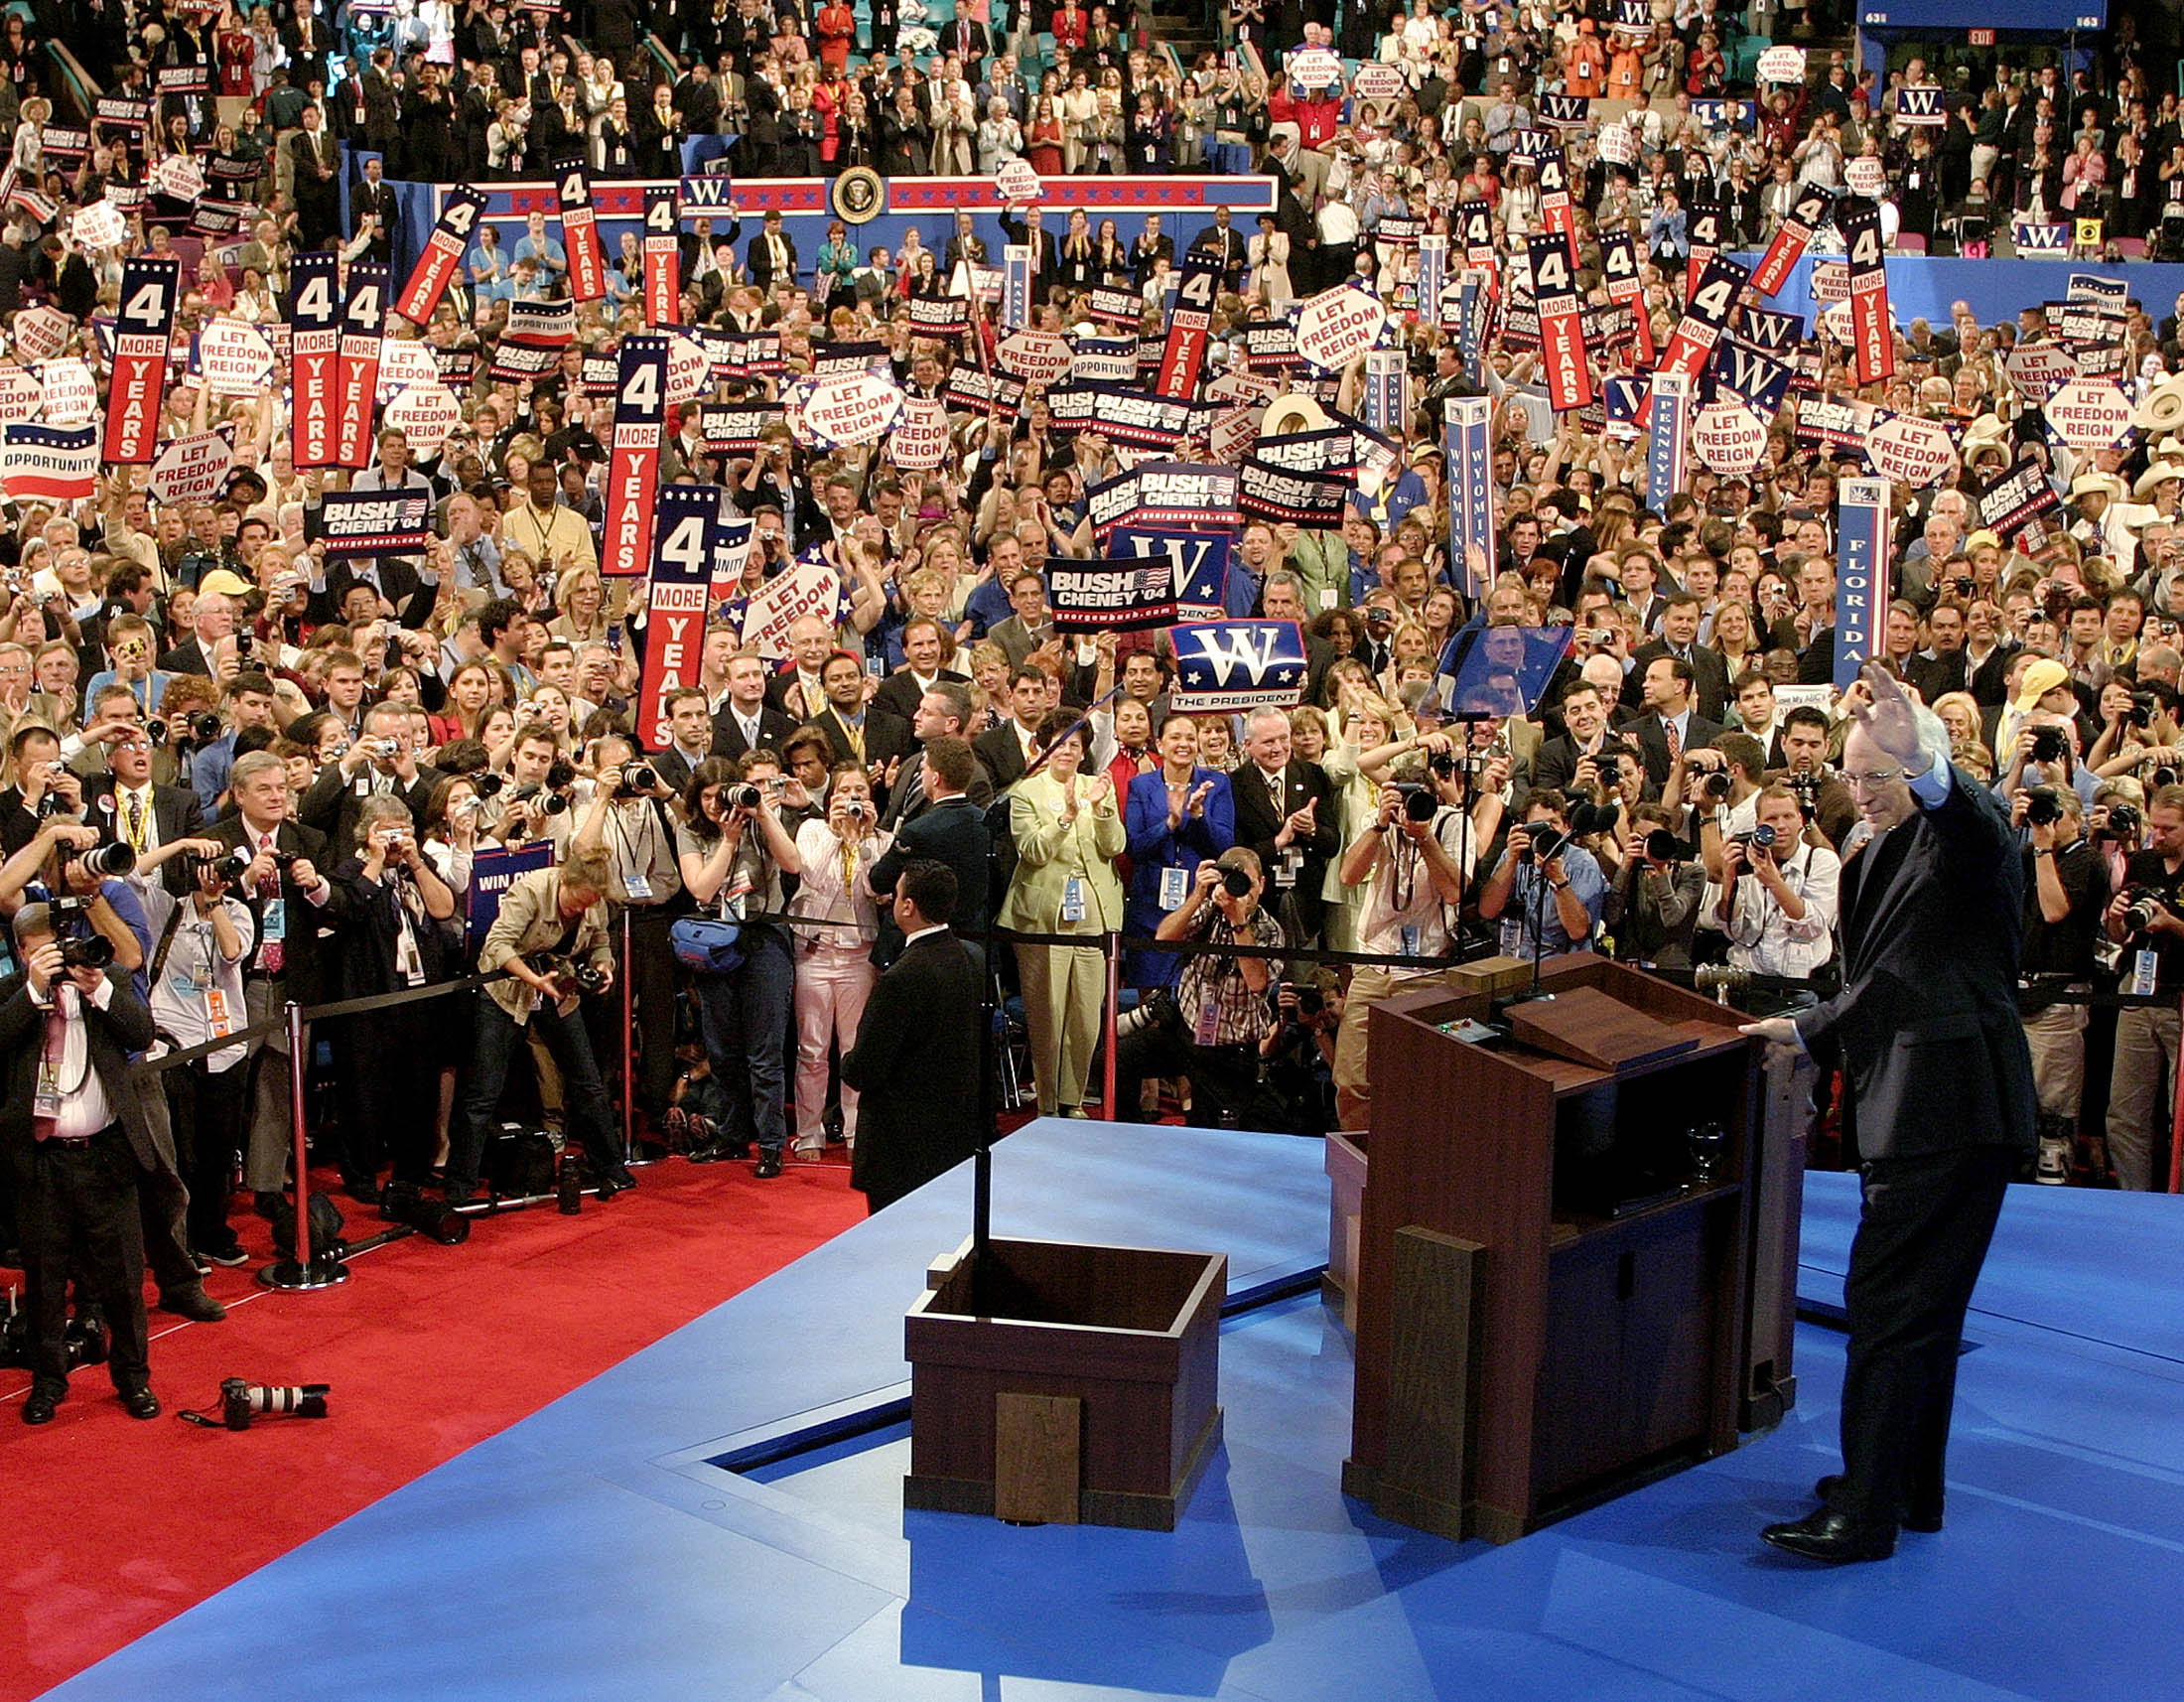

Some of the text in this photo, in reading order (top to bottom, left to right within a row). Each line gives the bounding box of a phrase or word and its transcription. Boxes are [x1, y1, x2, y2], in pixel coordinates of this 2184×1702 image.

[1624, 1, 1649, 23] W
[1972, 31, 1993, 45] EXIT
[1548, 95, 1581, 119] W
[1904, 91, 1936, 114] W
[1521, 131, 1550, 155] W
[1541, 162, 1563, 189] 4
[561, 174, 587, 205] 4
[688, 179, 724, 206] W
[1544, 194, 1568, 206] MORE
[445, 203, 476, 234] 4
[565, 211, 593, 224] MORE
[647, 202, 673, 231] 4
[1796, 199, 1823, 225] 4
[1468, 214, 1488, 242] 4
[1694, 216, 1716, 243] 4
[1785, 221, 1811, 239] MORE
[2025, 226, 2062, 248] W
[433, 233, 463, 253] MORE
[648, 240, 675, 250] MORE
[1852, 229, 1879, 266] 4
[575, 227, 594, 295] YEARS
[1469, 250, 1491, 259] MORE
[1607, 246, 1633, 275] 4
[1760, 236, 1797, 289] YEARS
[1539, 252, 1569, 290] 4
[408, 250, 449, 317] YEARS
[656, 254, 668, 322] YEARS
[1182, 273, 1212, 306] 4
[1421, 264, 1430, 317] ALASK
[1611, 282, 1638, 293] MORE
[1853, 274, 1883, 292] MORE
[125, 284, 165, 328] 4
[297, 277, 332, 323] 4
[910, 299, 954, 313] BUSH
[1093, 289, 1128, 305] BUSH
[1541, 299, 1574, 315] MORE
[1694, 280, 1732, 322] 4
[348, 286, 379, 330] 4
[911, 311, 953, 323] CHENEY
[1316, 301, 1346, 323] LET
[511, 318, 574, 331] OPPORTUNITY
[1175, 312, 1207, 327] MORE
[1301, 307, 1379, 351] FREEDOM
[1748, 310, 1793, 348] W
[2062, 316, 2106, 332] BUSH
[221, 332, 247, 344] LET
[297, 334, 335, 351] MORE
[1680, 321, 1715, 346] MORE
[1863, 295, 1883, 375] YEARS
[2062, 328, 2105, 340] CHENEY
[121, 339, 164, 353] MORE
[203, 345, 268, 361] FREEDOM
[343, 340, 378, 355] MORE
[495, 346, 545, 361] BUSH
[1024, 342, 1052, 354] LET
[1320, 329, 1370, 360] REIGN
[209, 360, 256, 373] REIGN
[390, 354, 417, 364] LET
[815, 356, 868, 374] BUSH
[1002, 351, 1069, 366] FREEDOM
[1554, 318, 1578, 404] YEARS
[2022, 355, 2048, 368] LET
[50, 370, 76, 383] LET
[949, 367, 1004, 391] BUSH
[1012, 367, 1055, 379] REIGN
[1731, 347, 1782, 397] W
[2010, 366, 2077, 381] FREEDOM
[622, 363, 659, 414] 4
[831, 385, 863, 402] LET
[1001, 392, 1017, 404] '04
[1235, 382, 1263, 396] LET
[2077, 392, 2106, 404] LET
[120, 361, 150, 458] YEARS
[307, 357, 326, 460] YEARS
[339, 361, 366, 462] YEARS
[416, 396, 442, 407] LET
[812, 393, 893, 422] FREEDOM
[1095, 393, 1161, 417] BUSH
[1798, 400, 1854, 421] BUSH
[392, 410, 457, 422] FREEDOM
[703, 412, 760, 428] BUSH
[831, 412, 884, 436] REIGN
[906, 413, 933, 424] LET
[1097, 408, 1160, 428] CHENEY
[1162, 417, 1182, 430] '04
[1712, 416, 1739, 429] LET
[1800, 415, 1852, 432] CHENEY
[2052, 406, 2128, 421] FREEDOM
[405, 425, 445, 437] REIGN
[617, 428, 657, 444] MORE
[706, 426, 761, 439] CHENEY
[1225, 417, 1252, 436] LET
[1697, 430, 1762, 444] FREEDOM
[2066, 423, 2114, 437] REIGN
[1900, 428, 1934, 447] LET
[182, 445, 209, 462] LET
[895, 444, 941, 456] REIGN
[1257, 440, 1324, 463] BUSH
[1330, 453, 1349, 467] '04
[1654, 400, 1673, 511] PENNSYLVA
[1706, 450, 1754, 462] REIGN
[1871, 437, 1950, 464] FREEDOM
[5, 453, 96, 473] OPPORTUNITY
[156, 458, 228, 484] FREEDOM
[1881, 457, 1931, 477] REIGN
[167, 477, 214, 496] REIGN
[1141, 473, 1209, 494] BUSH
[1242, 466, 1311, 497] BUSH
[1145, 493, 1232, 507] CHENEY '04
[1245, 485, 1338, 508] CHENEY '04
[1471, 449, 1485, 548] WYOMIN
[1979, 475, 2023, 516] BUSH
[1985, 480, 2044, 525] CHENEY '04
[324, 500, 397, 522] BUSH
[617, 454, 645, 568] YEARS
[1094, 496, 1139, 524] CHENE
[1449, 449, 1463, 565] WYOMING
[328, 517, 422, 534] CHENEY '04
[661, 517, 706, 573] 4
[1051, 571, 1136, 592] BUSH
[655, 588, 703, 607] MORE
[766, 580, 801, 614] LET
[1057, 587, 1166, 608] CHENEY '04
[1843, 540, 1867, 661] FLORIDA
[751, 575, 833, 647] FREEDOM
[1191, 628, 1279, 687] W
[1175, 693, 1297, 707] THE PRESIDENT
[478, 874, 509, 891] WIN
